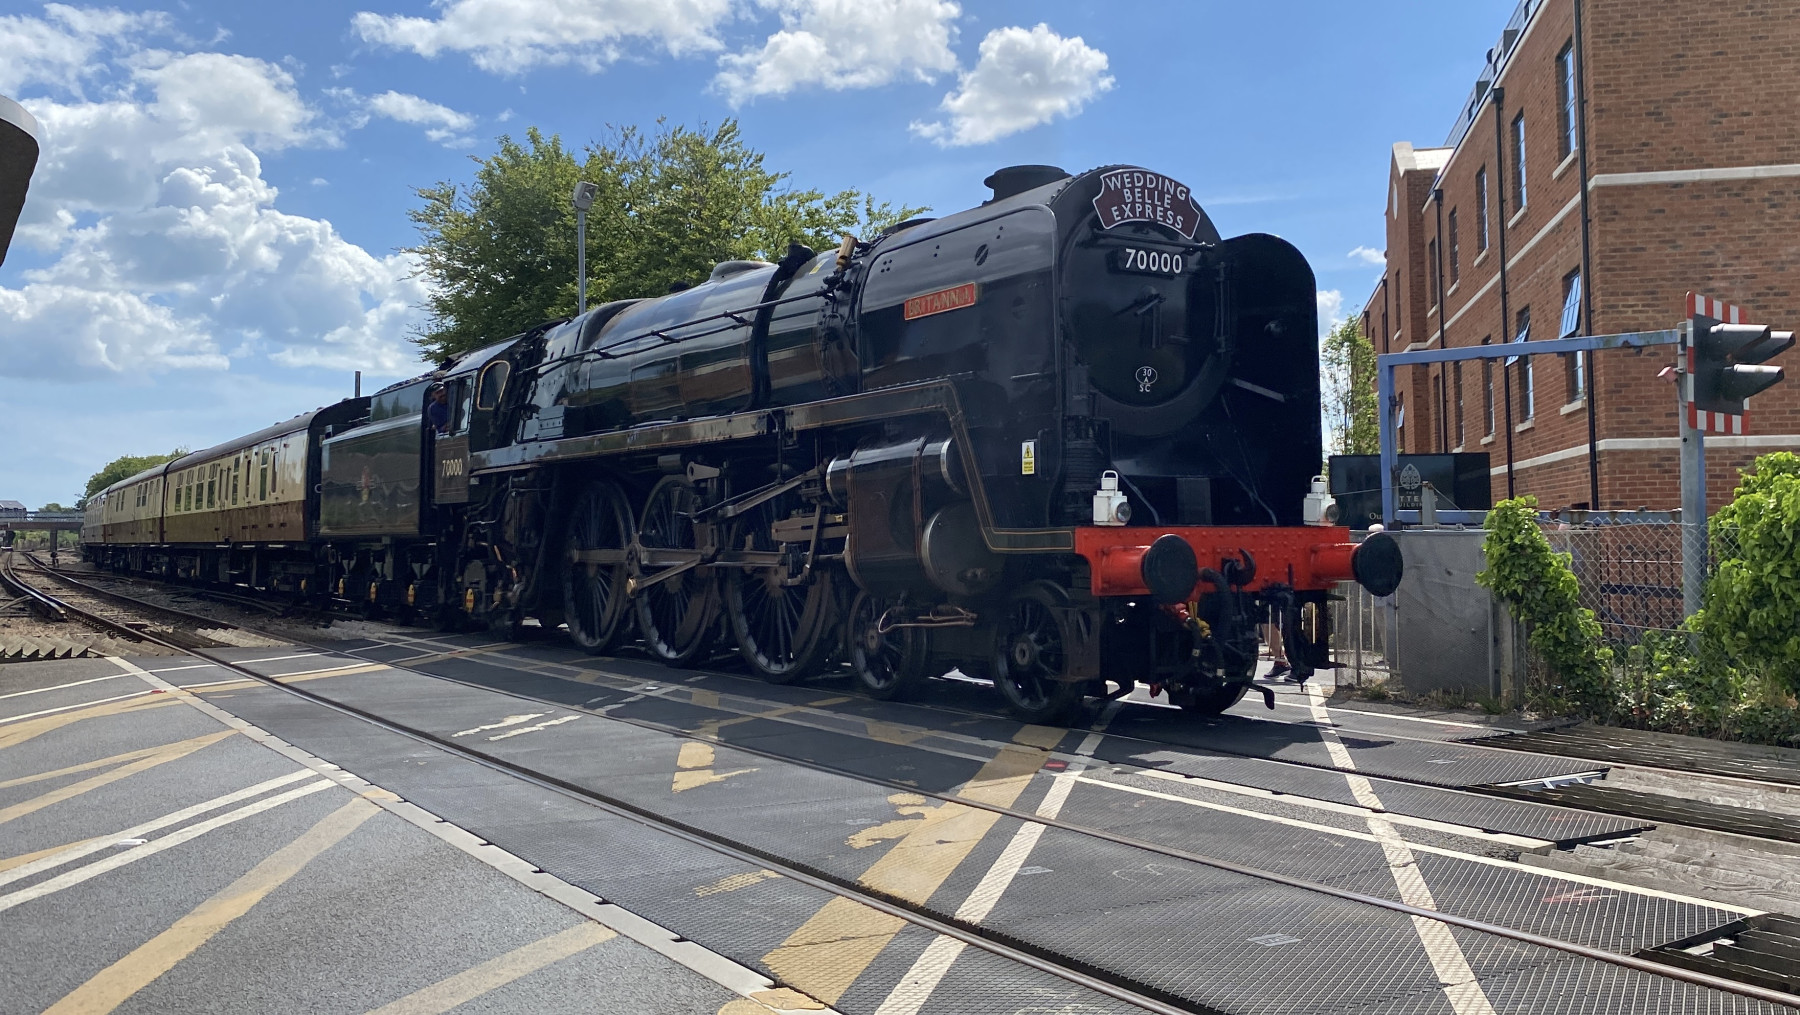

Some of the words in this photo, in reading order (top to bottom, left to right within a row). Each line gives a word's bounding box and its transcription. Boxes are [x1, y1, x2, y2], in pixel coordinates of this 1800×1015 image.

[1106, 172, 1187, 201] WEDDING
[1123, 188, 1172, 209] BELLE
[1111, 203, 1184, 229] EXPRESS
[1125, 248, 1182, 274] 70000
[1142, 368, 1152, 377] 30
[1139, 384, 1151, 392] SC
[441, 458, 463, 477] 70000
